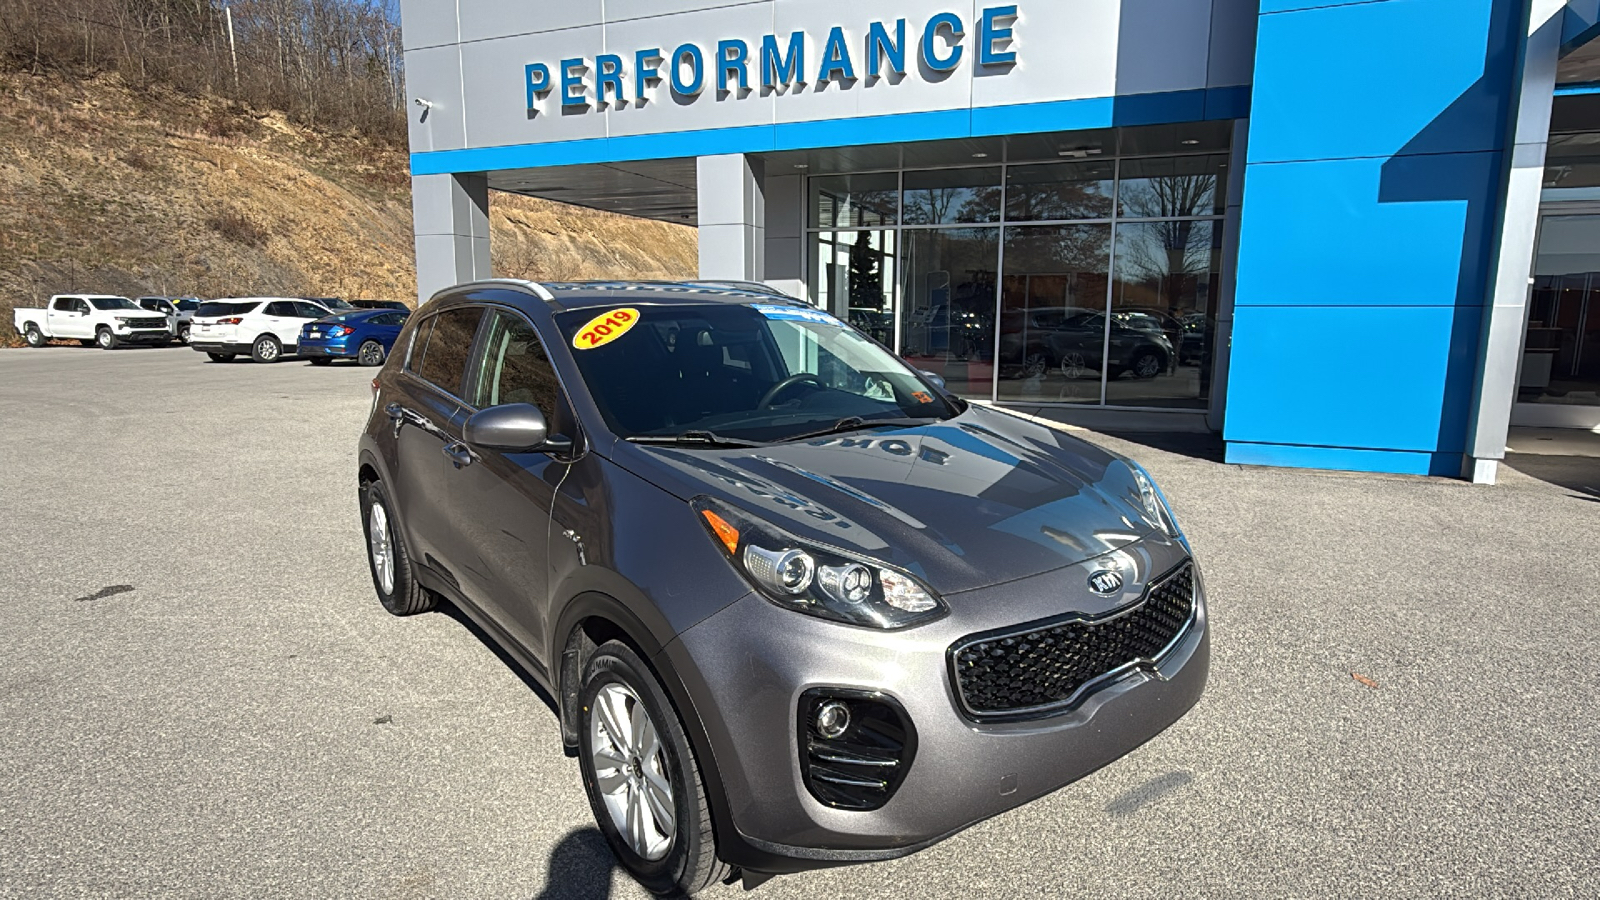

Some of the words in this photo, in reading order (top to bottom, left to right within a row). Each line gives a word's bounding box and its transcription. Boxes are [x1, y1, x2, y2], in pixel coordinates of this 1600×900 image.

[524, 5, 1018, 117] PERFORMANCE
[582, 311, 632, 345] 2019
[1091, 572, 1121, 592] KIA
